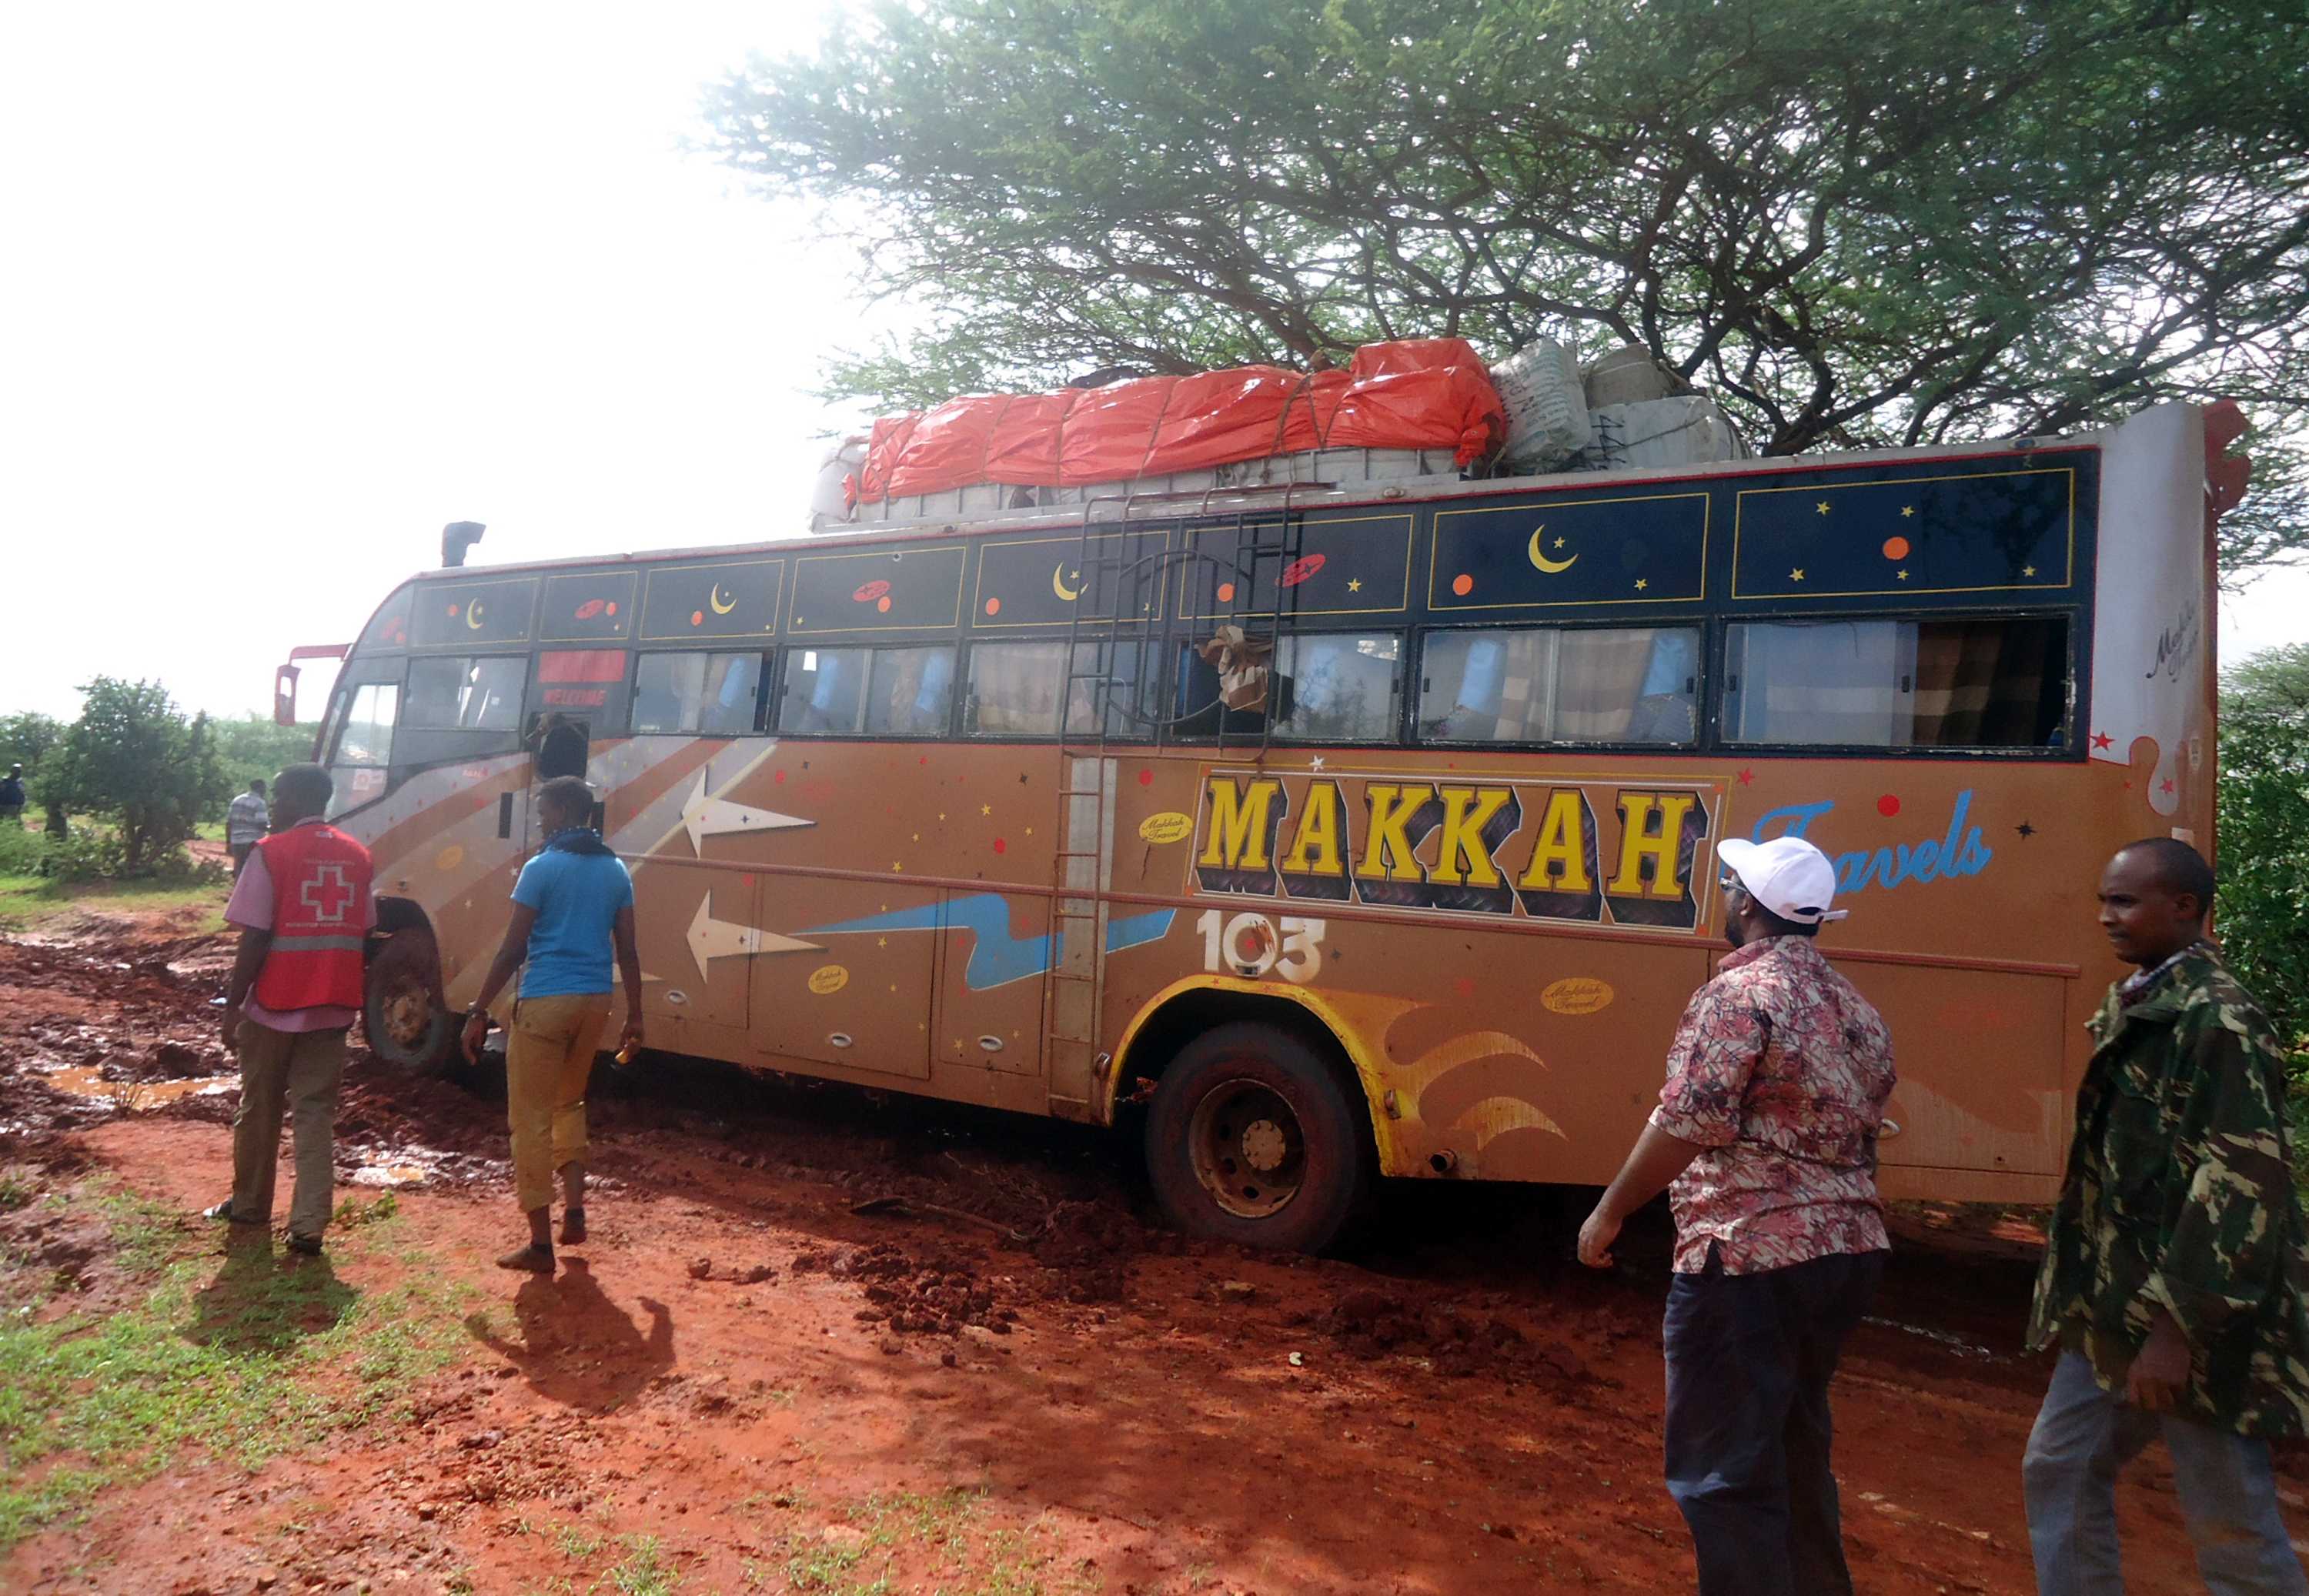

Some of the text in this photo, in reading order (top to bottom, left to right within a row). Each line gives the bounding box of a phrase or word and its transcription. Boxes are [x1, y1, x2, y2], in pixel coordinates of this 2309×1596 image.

[1198, 777, 1698, 905] MAKKAH
[1719, 788, 1993, 894] Tavels
[1197, 909, 1326, 984] 103
